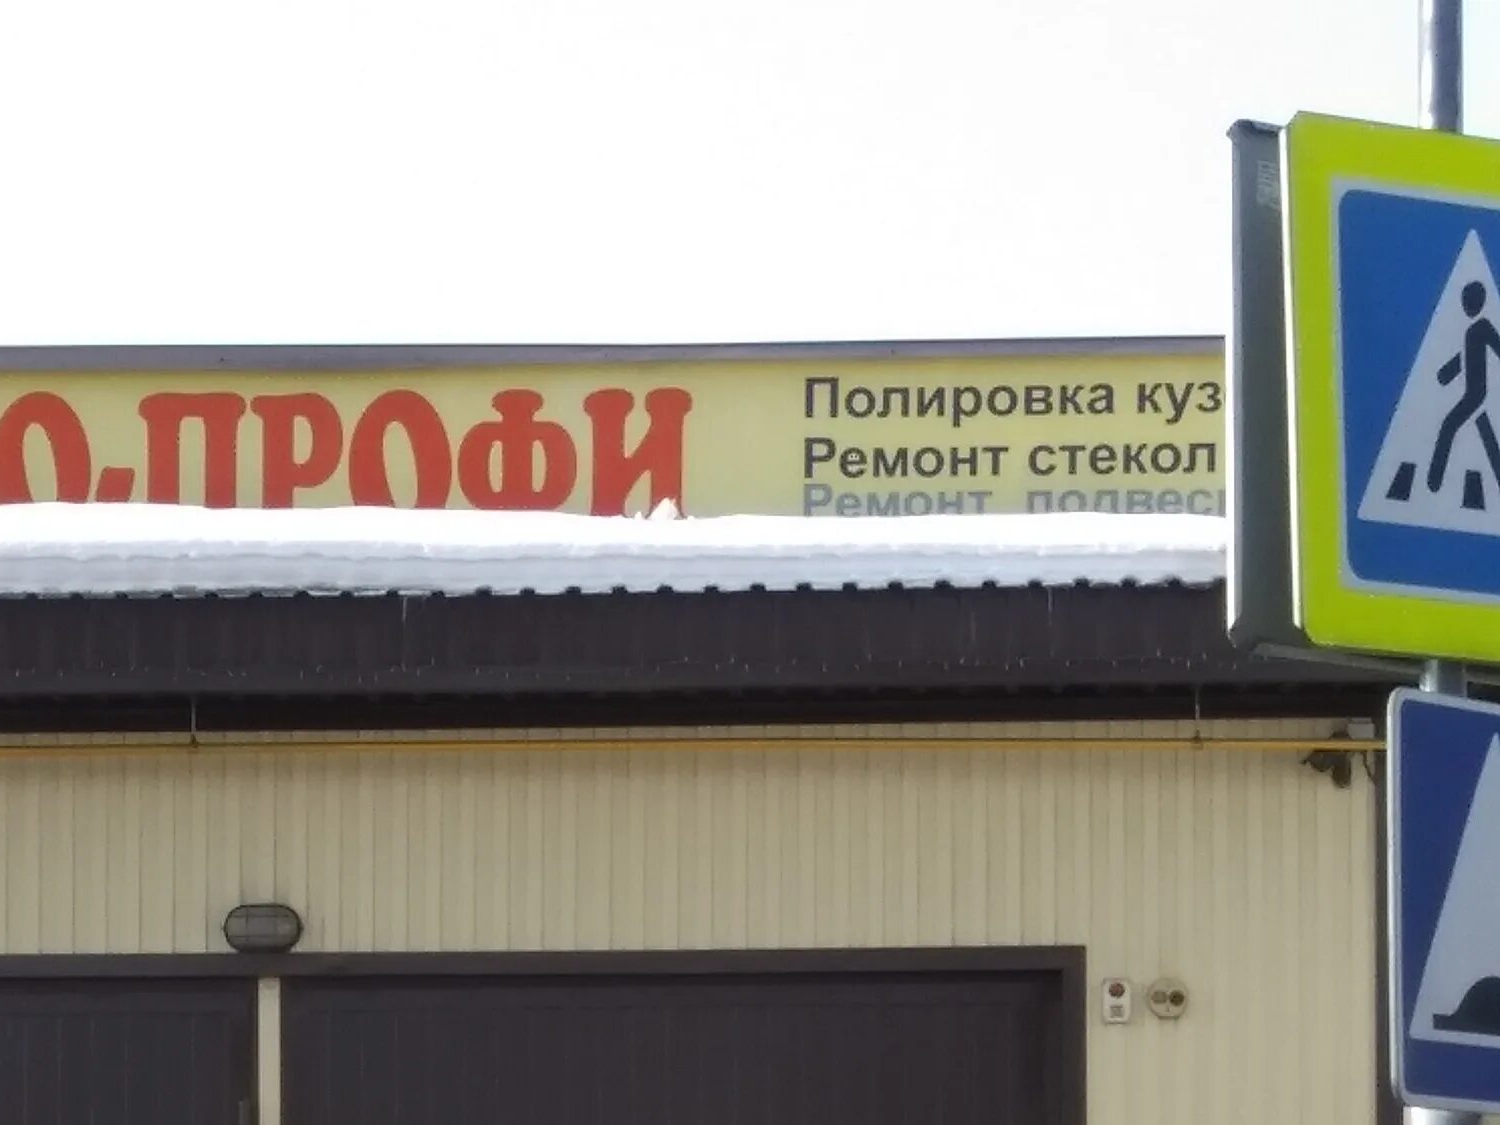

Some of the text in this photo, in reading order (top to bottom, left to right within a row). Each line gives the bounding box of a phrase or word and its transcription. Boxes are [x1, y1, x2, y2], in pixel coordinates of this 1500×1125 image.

[803, 376, 1226, 427] Полировка куз
[803, 436, 1217, 478] Ремонт стекол
[803, 483, 1227, 517] Ремонт подвес
